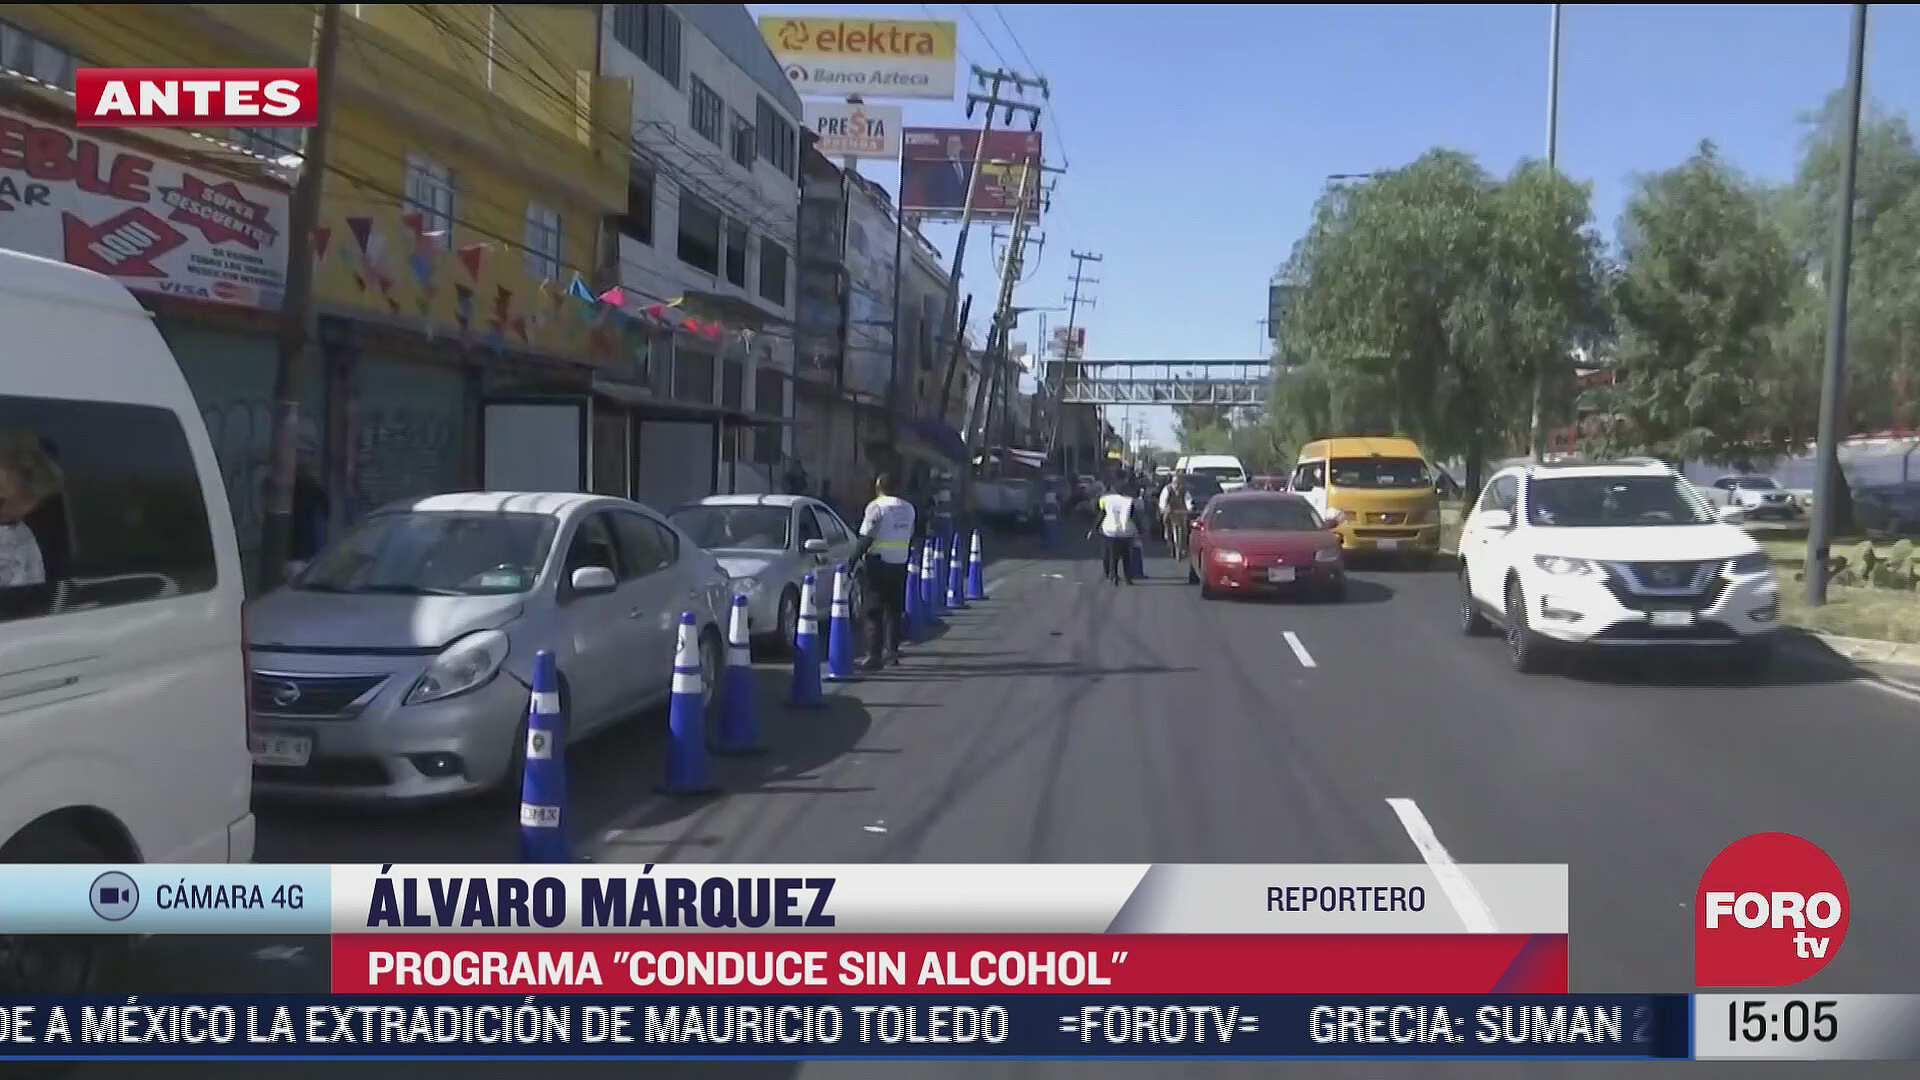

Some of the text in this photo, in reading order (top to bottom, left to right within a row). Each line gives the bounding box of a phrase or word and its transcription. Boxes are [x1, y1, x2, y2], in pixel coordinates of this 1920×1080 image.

[815, 22, 934, 56] elektra
[813, 68, 930, 86] Banco Azteca
[160, 281, 209, 298] VISA
